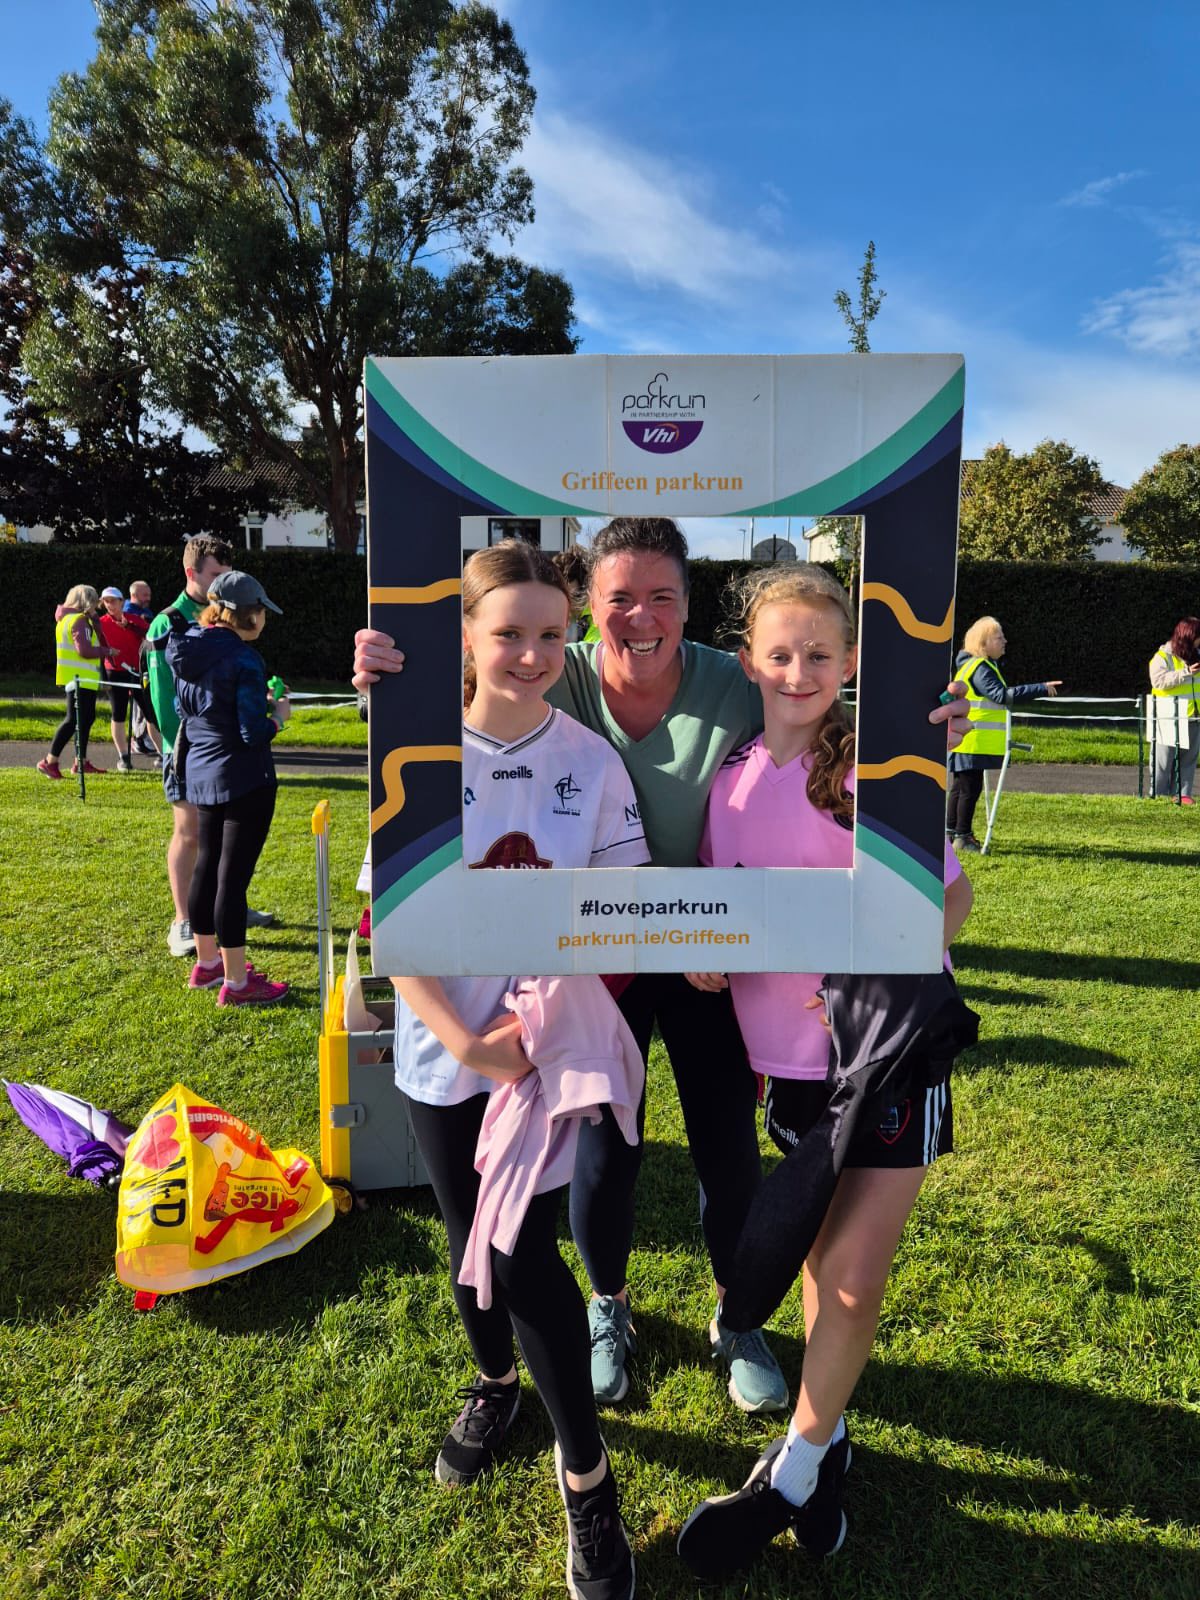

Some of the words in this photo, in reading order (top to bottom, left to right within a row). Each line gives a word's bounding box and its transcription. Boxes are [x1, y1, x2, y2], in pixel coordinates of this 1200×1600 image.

[621, 373, 706, 413] parkrun
[642, 427, 677, 443] Vhi
[561, 471, 649, 491] Griffeen
[655, 471, 744, 495] parkrun
[580, 899, 729, 918] #loveparkrun
[558, 929, 750, 950] parkrun.ie/Griffeen
